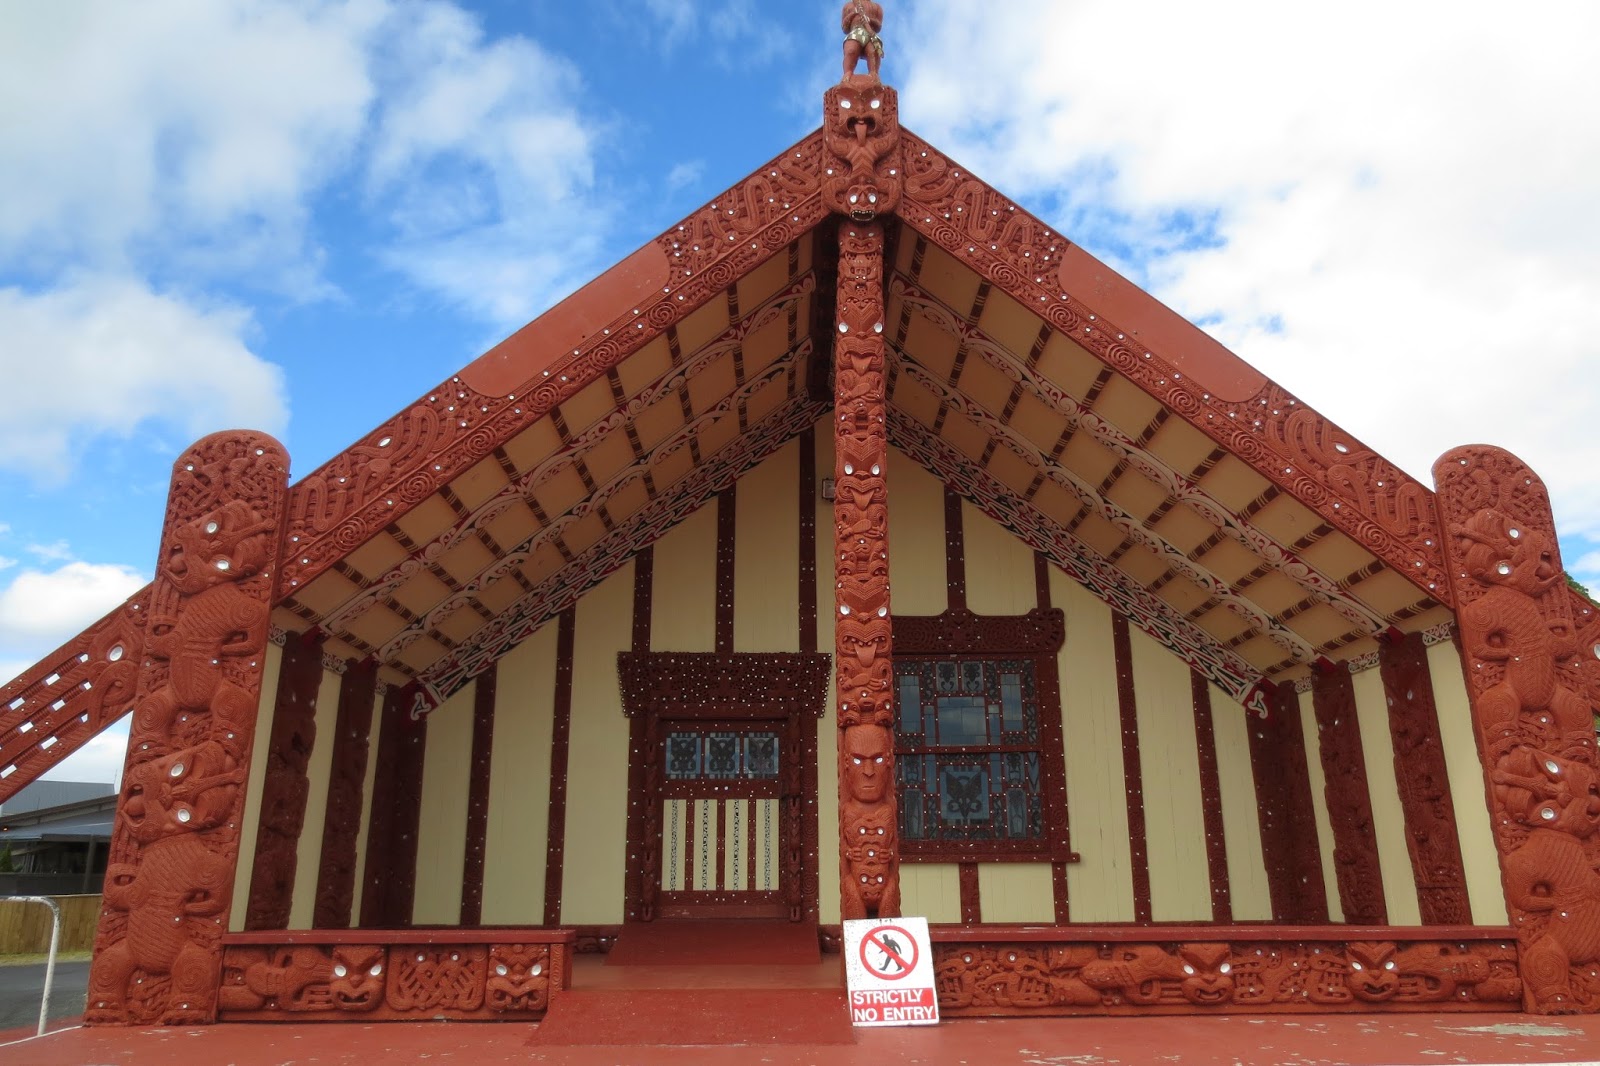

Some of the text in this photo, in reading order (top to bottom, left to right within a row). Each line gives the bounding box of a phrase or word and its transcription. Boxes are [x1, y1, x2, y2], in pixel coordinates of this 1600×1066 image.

[853, 989, 923, 1004] STRICTLY
[854, 1006, 933, 1021] NO ENTRY
